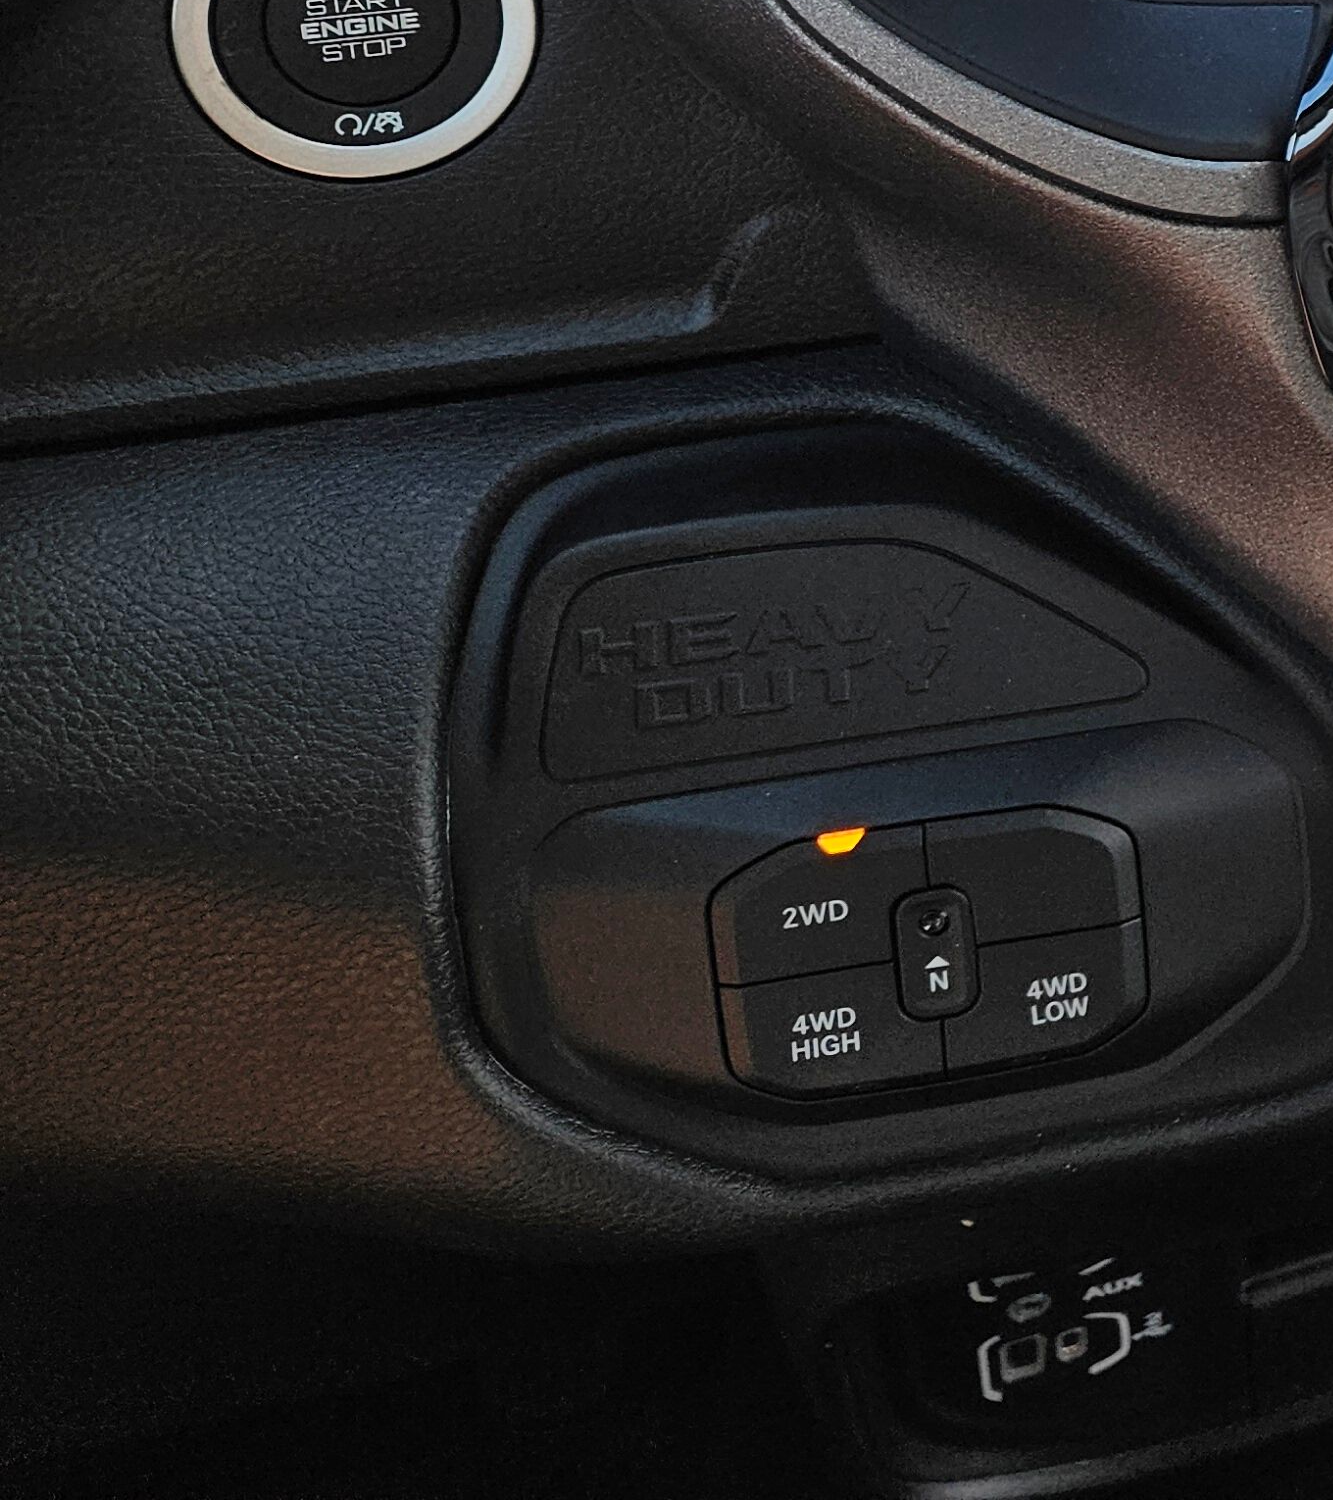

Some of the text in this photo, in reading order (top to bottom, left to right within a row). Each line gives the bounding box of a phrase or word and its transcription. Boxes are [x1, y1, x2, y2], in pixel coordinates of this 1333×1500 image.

[300, 12, 421, 41] ENGINE
[323, 36, 406, 62] STOP
[577, 581, 971, 678] HEAVY
[634, 644, 952, 731] DUTY
[781, 898, 850, 930] 2WD
[928, 969, 950, 993] N
[1025, 972, 1088, 1002] 4WD
[791, 1006, 857, 1036] 4WD
[1030, 995, 1090, 1026] LOW
[790, 1030, 862, 1063] HIGH
